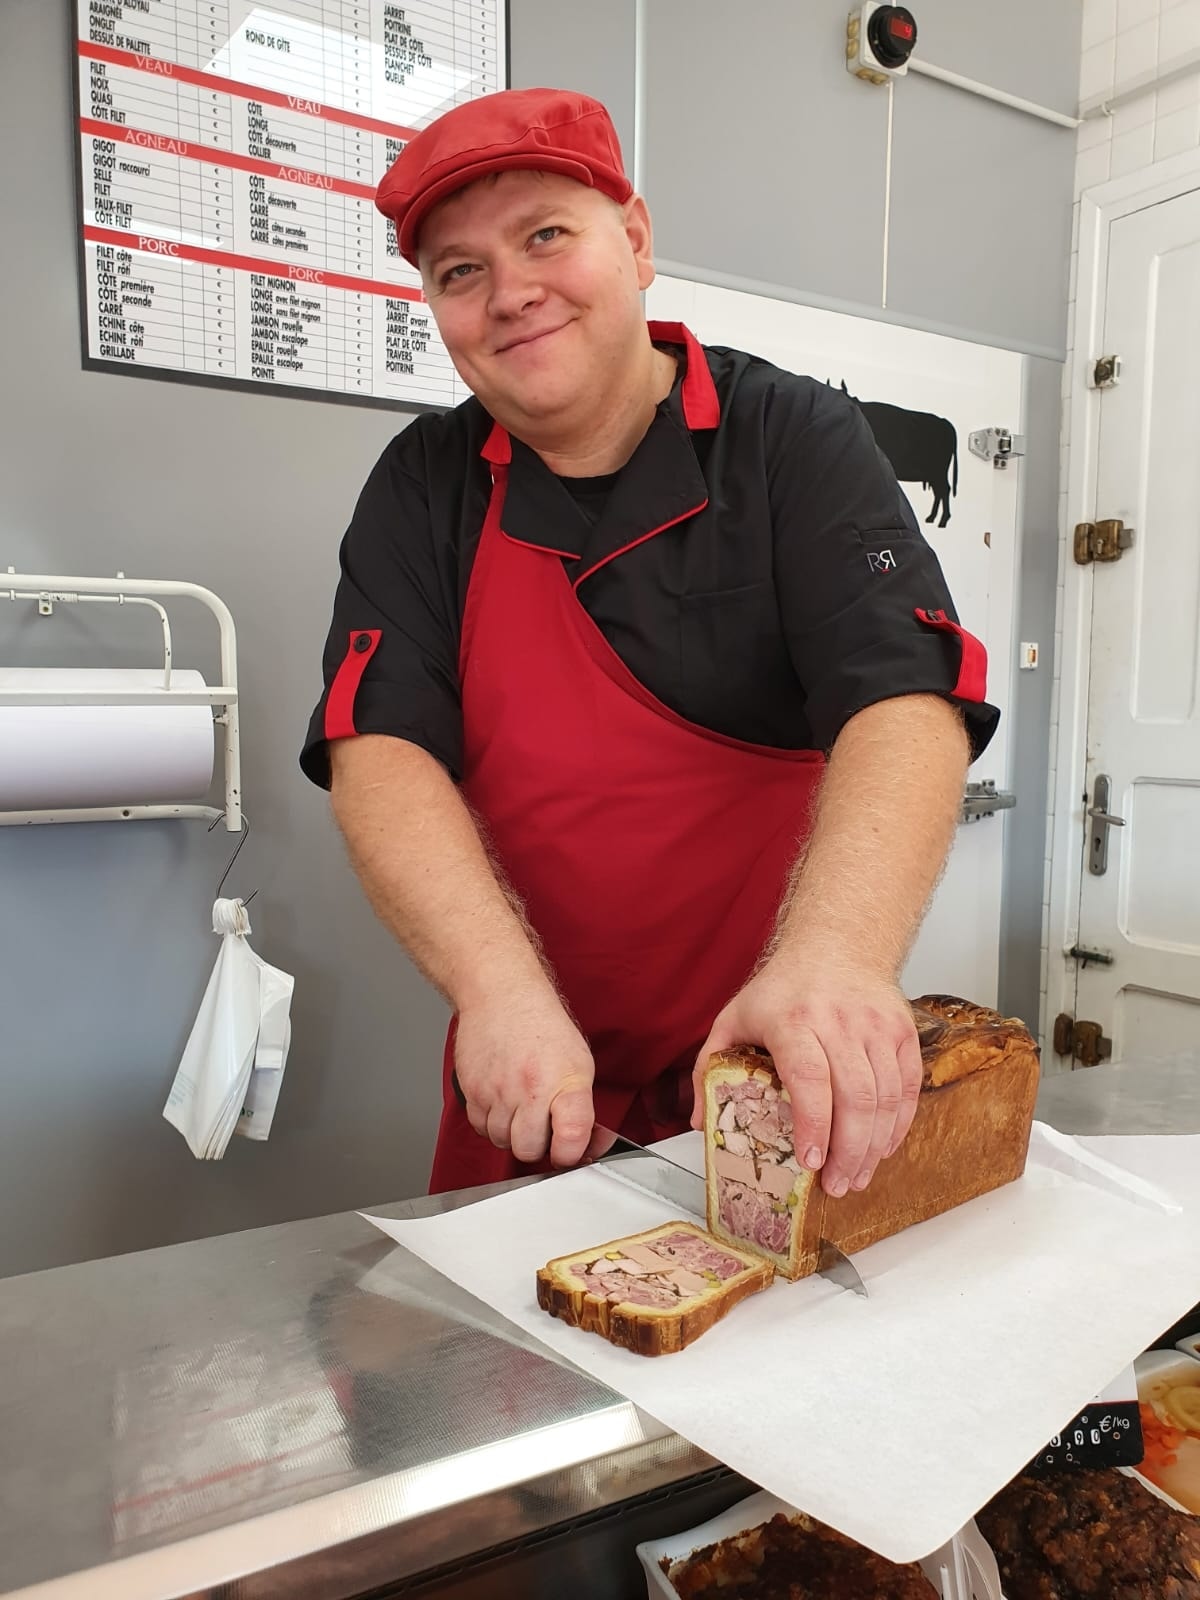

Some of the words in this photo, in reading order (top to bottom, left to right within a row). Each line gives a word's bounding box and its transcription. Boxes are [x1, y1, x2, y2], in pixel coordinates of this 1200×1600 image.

[89, 15, 115, 31] ONGLET
[89, 29, 114, 45] DESSUS
[115, 35, 124, 48] DE
[126, 38, 150, 55] PALETTE
[245, 29, 265, 46] ROND
[267, 36, 275, 49] DE
[384, 31, 398, 45] PLAT
[400, 36, 407, 48] DE
[90, 61, 106, 75] FILET
[134, 54, 173, 75] VEAU
[90, 76, 109, 91] NOIX
[385, 70, 405, 85] QUEUE
[90, 90, 112, 105] QUASI
[287, 95, 321, 114] VEAU
[110, 109, 126, 124] FILET
[247, 116, 268, 132] LONGE
[92, 138, 116, 154] GIGOT
[125, 129, 187, 154] AGNEAU
[248, 144, 271, 159] COLLIER
[93, 153, 116, 169] GIGOT
[93, 168, 112, 182] SELLE
[278, 166, 333, 190] AGNEAU
[94, 182, 111, 196] FILET
[94, 197, 133, 216] FAUX-FILET
[95, 211, 113, 225] CÔTE
[115, 215, 132, 229] FILET
[96, 245, 114, 259] FILET
[116, 249, 132, 263] côte
[138, 236, 180, 256] PORC
[97, 259, 115, 273] FILET
[288, 265, 324, 283] PORC
[97, 273, 117, 287] CÔTE
[250, 274, 266, 286] FILET
[267, 277, 296, 292] MIGNON
[98, 287, 117, 301] CÔTE
[121, 294, 152, 308] seconde
[251, 287, 273, 301] LONGE
[251, 300, 273, 314] LONGE
[386, 299, 410, 312] PALETTE
[251, 315, 279, 329] JAMBON
[386, 312, 408, 323] JARRET
[128, 321, 145, 334] côte
[386, 324, 408, 336] JARRET
[251, 328, 280, 342] JAMBON
[281, 333, 309, 347] escalope
[386, 336, 400, 348] PLAT
[402, 339, 410, 349] DE
[411, 340, 427, 352] CÔTE
[99, 344, 135, 360] GRILLADE
[386, 348, 413, 362] TRAVERS
[276, 357, 304, 371] escalope
[386, 361, 414, 374] POITRINE
[251, 366, 275, 380] POINTE
[1099, 1415, 1130, 1433] €/kg
